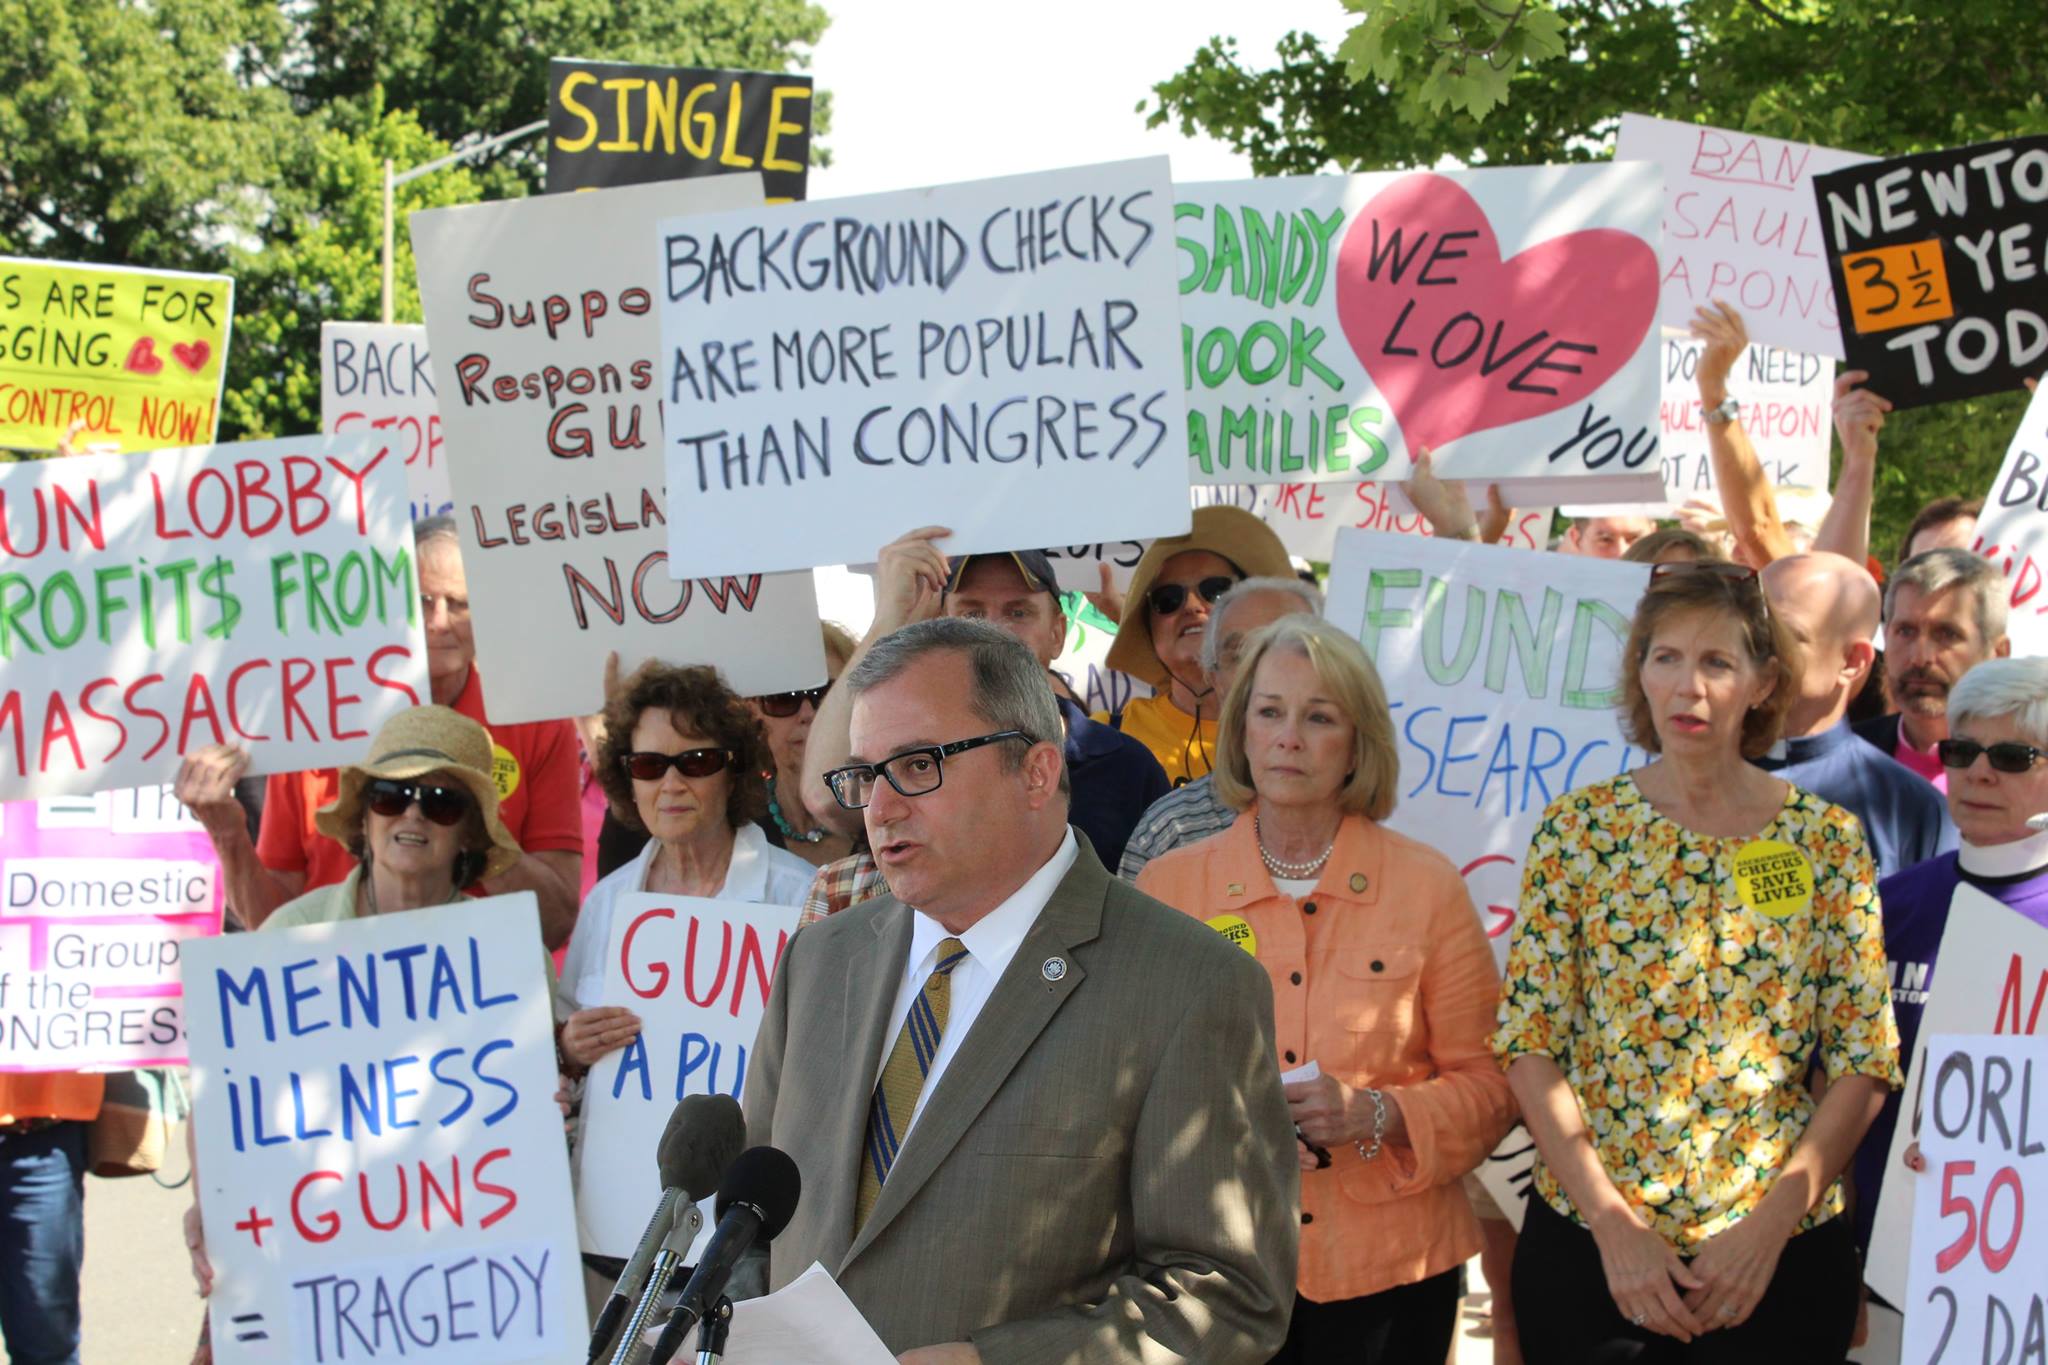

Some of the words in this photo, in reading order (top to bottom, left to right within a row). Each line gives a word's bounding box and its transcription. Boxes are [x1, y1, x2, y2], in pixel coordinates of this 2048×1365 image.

[555, 71, 811, 172] SINGLE
[1692, 131, 1809, 184] BAN
[666, 218, 968, 303] BACKGROUND
[981, 191, 1154, 273] CHECKS
[1174, 203, 1346, 308] SANDY
[1367, 219, 1479, 285] WE
[1664, 191, 1818, 258] SAUL
[1954, 222, 2048, 292] YE
[43, 280, 115, 319] ARE
[140, 285, 217, 328] FOR
[333, 339, 436, 396] BACK
[456, 353, 652, 406] Respons
[671, 340, 760, 403] ARE
[772, 324, 898, 391] MORE
[918, 300, 1143, 379] POPULAR
[1382, 299, 1598, 396] LOVE
[1749, 345, 1820, 386] NEED
[138, 396, 217, 443] NOW!
[547, 399, 664, 459] GU
[678, 416, 833, 492] THAN
[853, 391, 1168, 469] CONGRESS
[1549, 404, 1658, 469] YOU
[150, 446, 389, 540] LOBBY
[270, 545, 417, 636] FROM
[562, 550, 763, 630] NOW
[1359, 568, 1634, 710] FUND
[1389, 702, 1652, 817] SEARC
[9, 869, 207, 908] Domestic
[1737, 856, 1803, 878] CHECKS
[1750, 870, 1800, 892] SAVE
[1752, 883, 1806, 905] LIVES
[53, 934, 180, 975] Group
[620, 908, 788, 1018] GUN
[28, 972, 92, 1010] the
[216, 936, 520, 1049] MENTAL
[0, 1007, 188, 1051] NGRES
[612, 1030, 653, 1101] A
[675, 1032, 746, 1102] PU
[1935, 1160, 2024, 1274] 50
[293, 1249, 551, 1363] TRAGEDY
